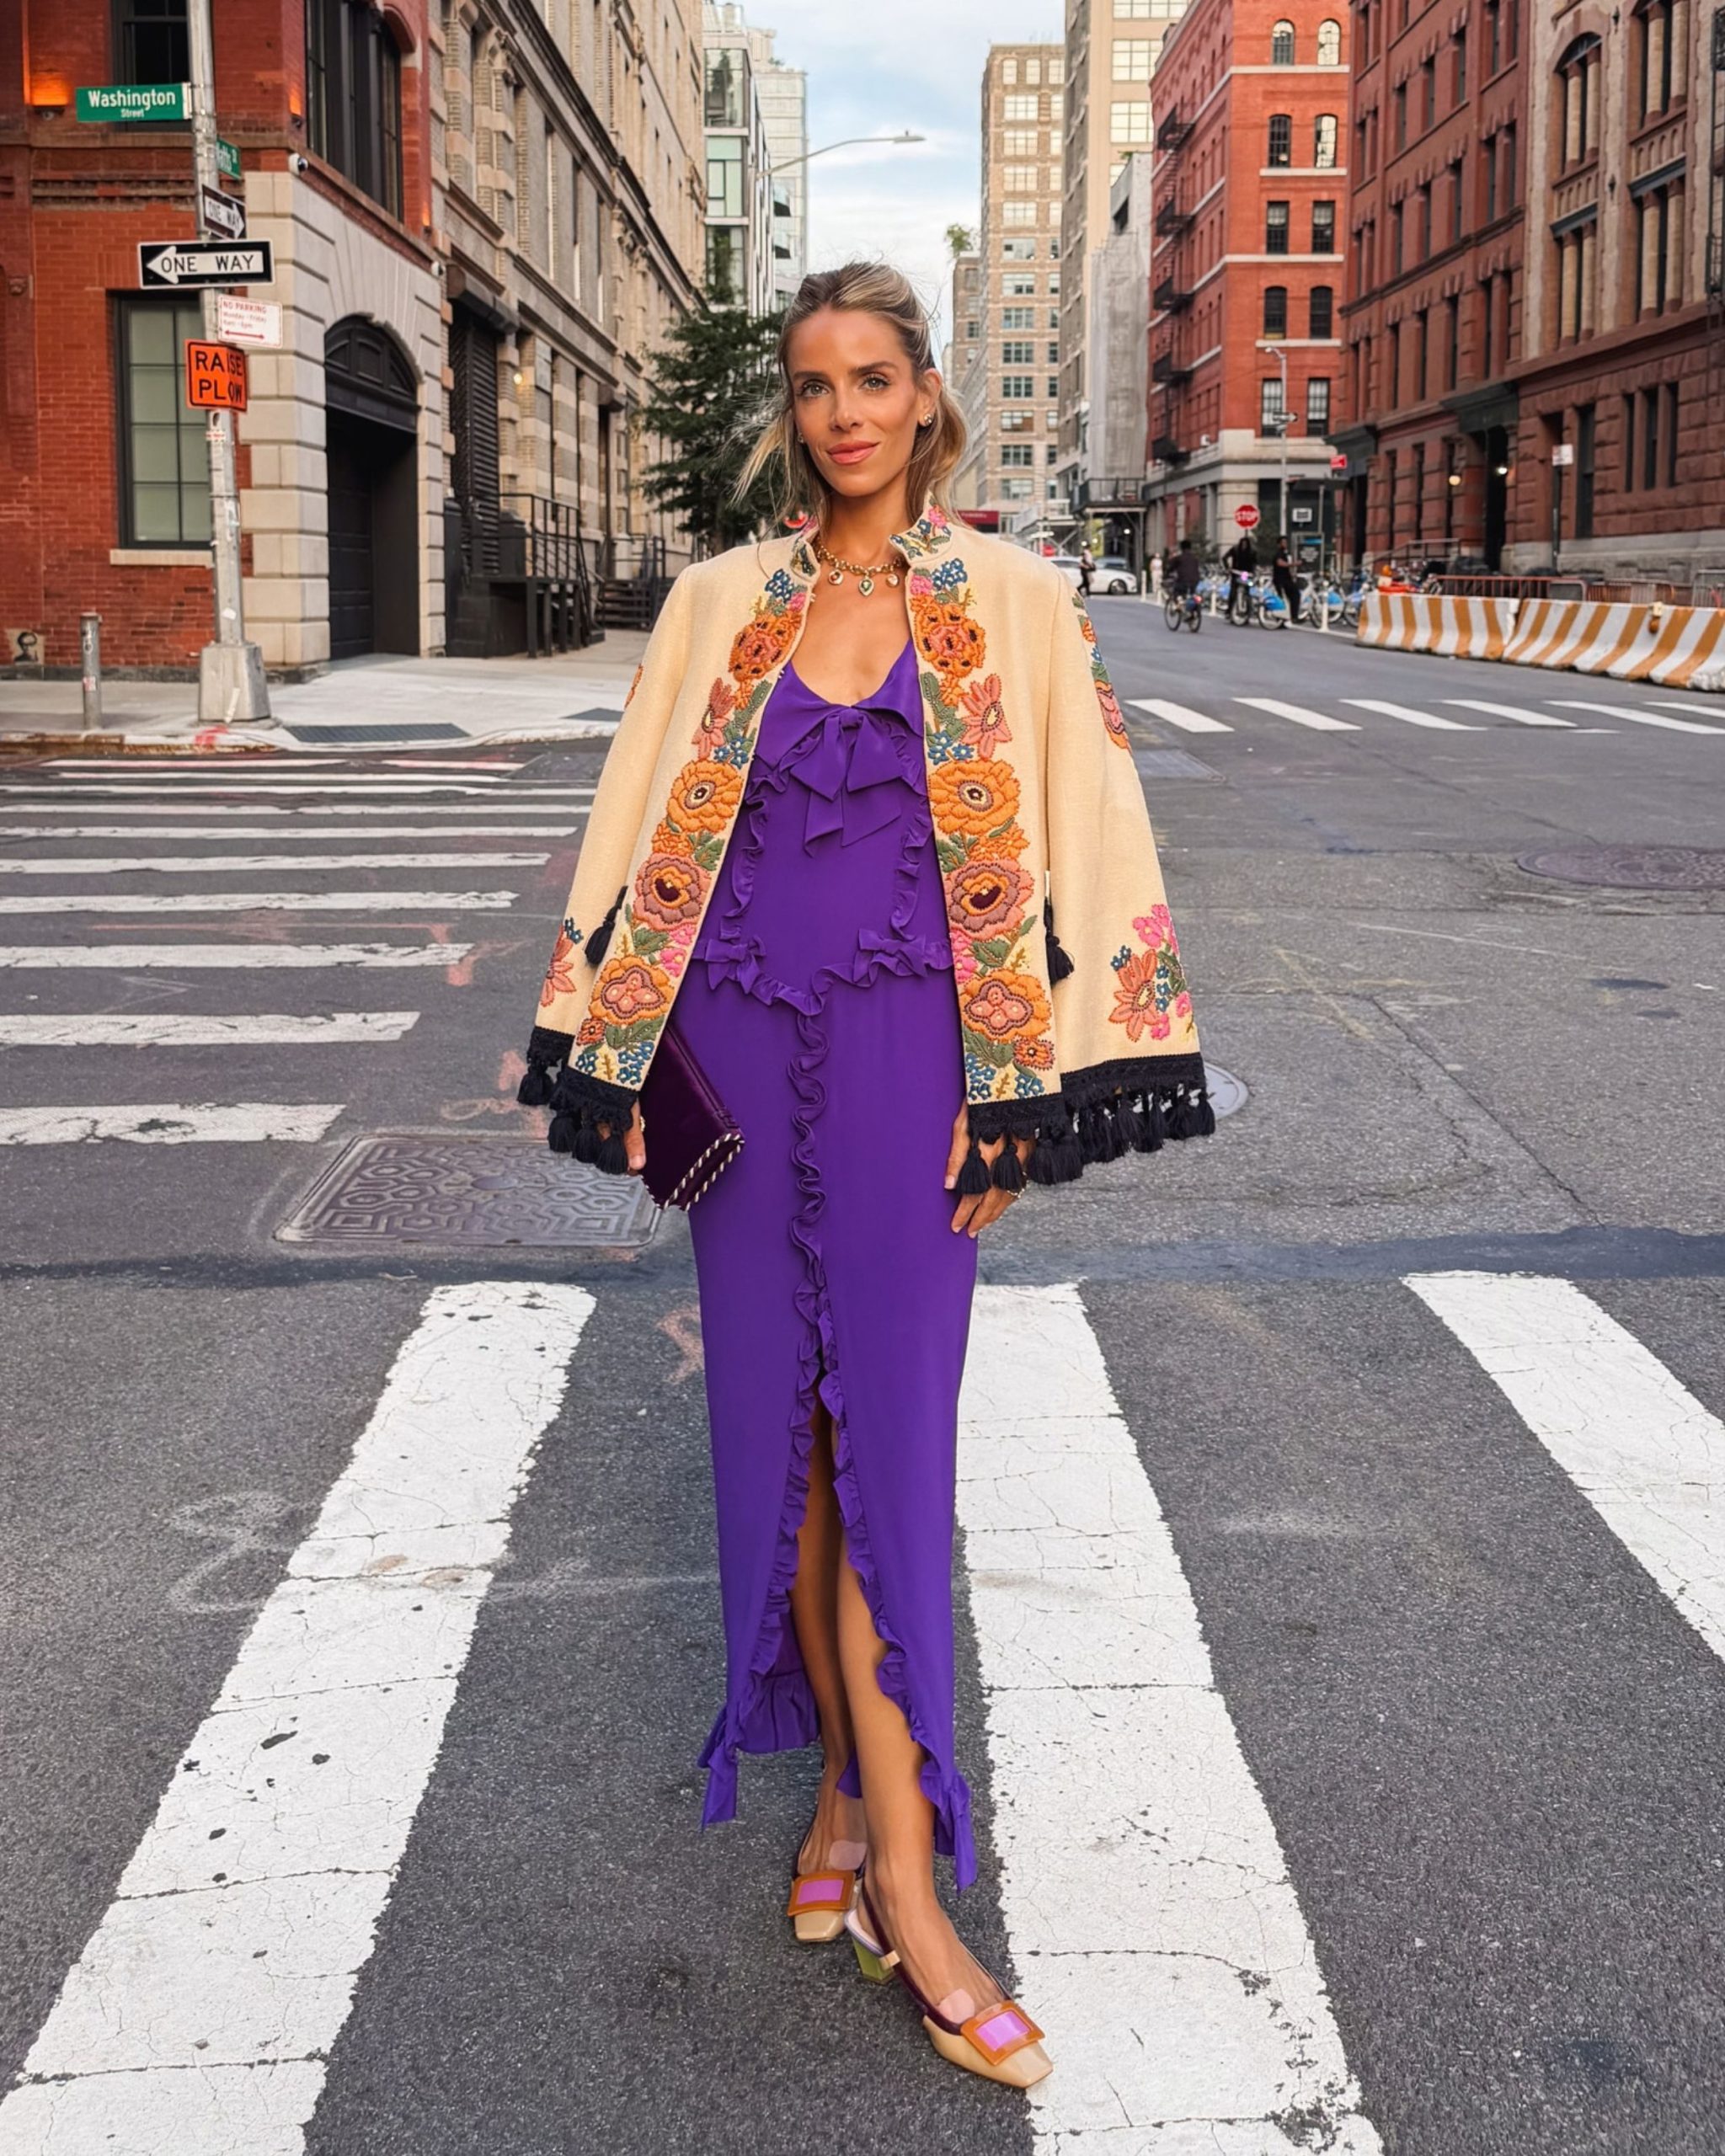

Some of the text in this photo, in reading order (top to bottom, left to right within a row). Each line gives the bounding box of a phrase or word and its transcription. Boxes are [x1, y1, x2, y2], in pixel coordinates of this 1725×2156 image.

[88, 88, 175, 110] Washington
[120, 109, 144, 117] Street
[207, 201, 240, 231] ONE WAY
[161, 254, 254, 273] ONE WAY
[223, 301, 267, 314] NO PARKING
[195, 350, 243, 376] RAISE
[199, 378, 243, 403] PLOW
[1236, 510, 1258, 522] STOP
